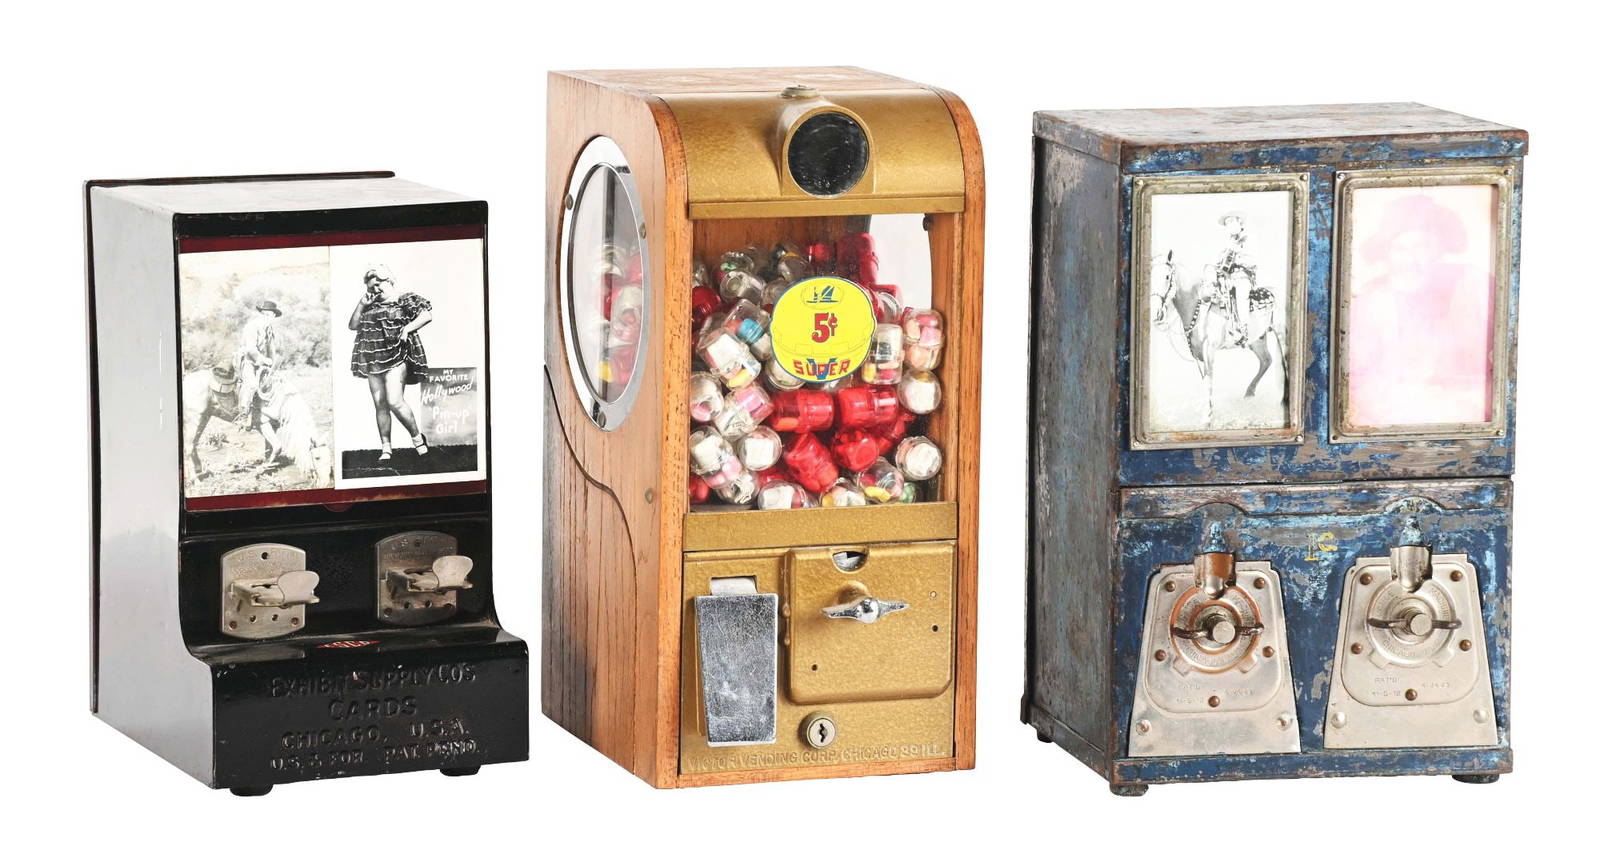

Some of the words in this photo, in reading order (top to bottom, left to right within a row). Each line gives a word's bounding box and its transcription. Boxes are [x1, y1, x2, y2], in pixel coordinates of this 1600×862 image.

[811, 312, 839, 343] 5¢
[429, 374, 469, 383] FAVORITE
[793, 359, 851, 377] SUPER
[435, 421, 458, 434] Girl
[355, 666, 434, 692] SUPPLY
[328, 696, 418, 721] CARDS
[688, 755, 738, 771] VICTOR
[741, 751, 798, 769] VENDING
[841, 745, 898, 762] CHICAGO
